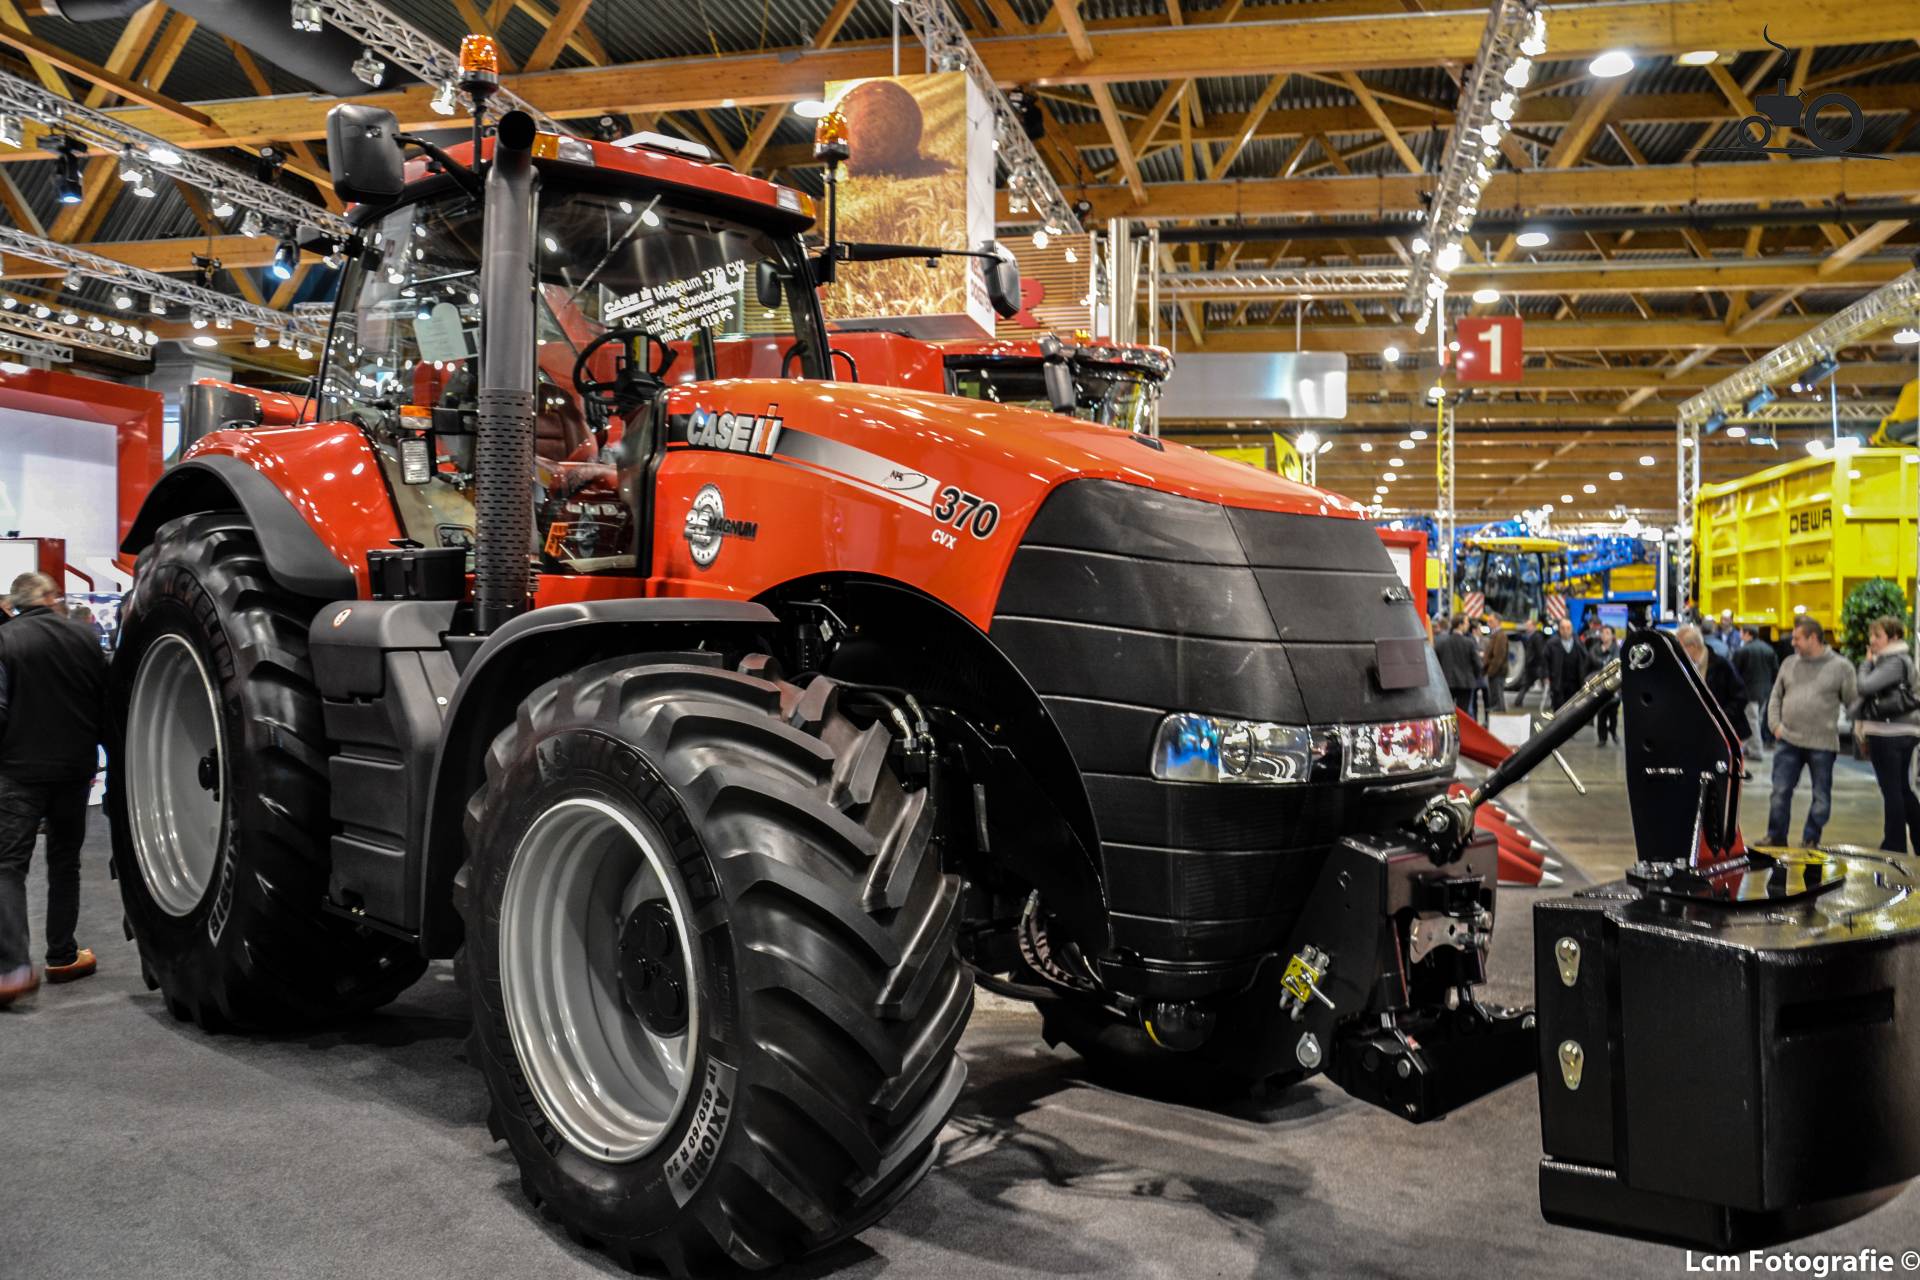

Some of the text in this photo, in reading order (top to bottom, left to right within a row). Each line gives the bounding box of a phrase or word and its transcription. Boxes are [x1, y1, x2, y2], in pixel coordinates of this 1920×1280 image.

[652, 276, 703, 301] Magnum
[1478, 324, 1502, 375] 1
[687, 408, 756, 452] CASE
[933, 485, 1000, 540] 370
[931, 528, 957, 550] CVX
[688, 1087, 713, 1150] 650/60
